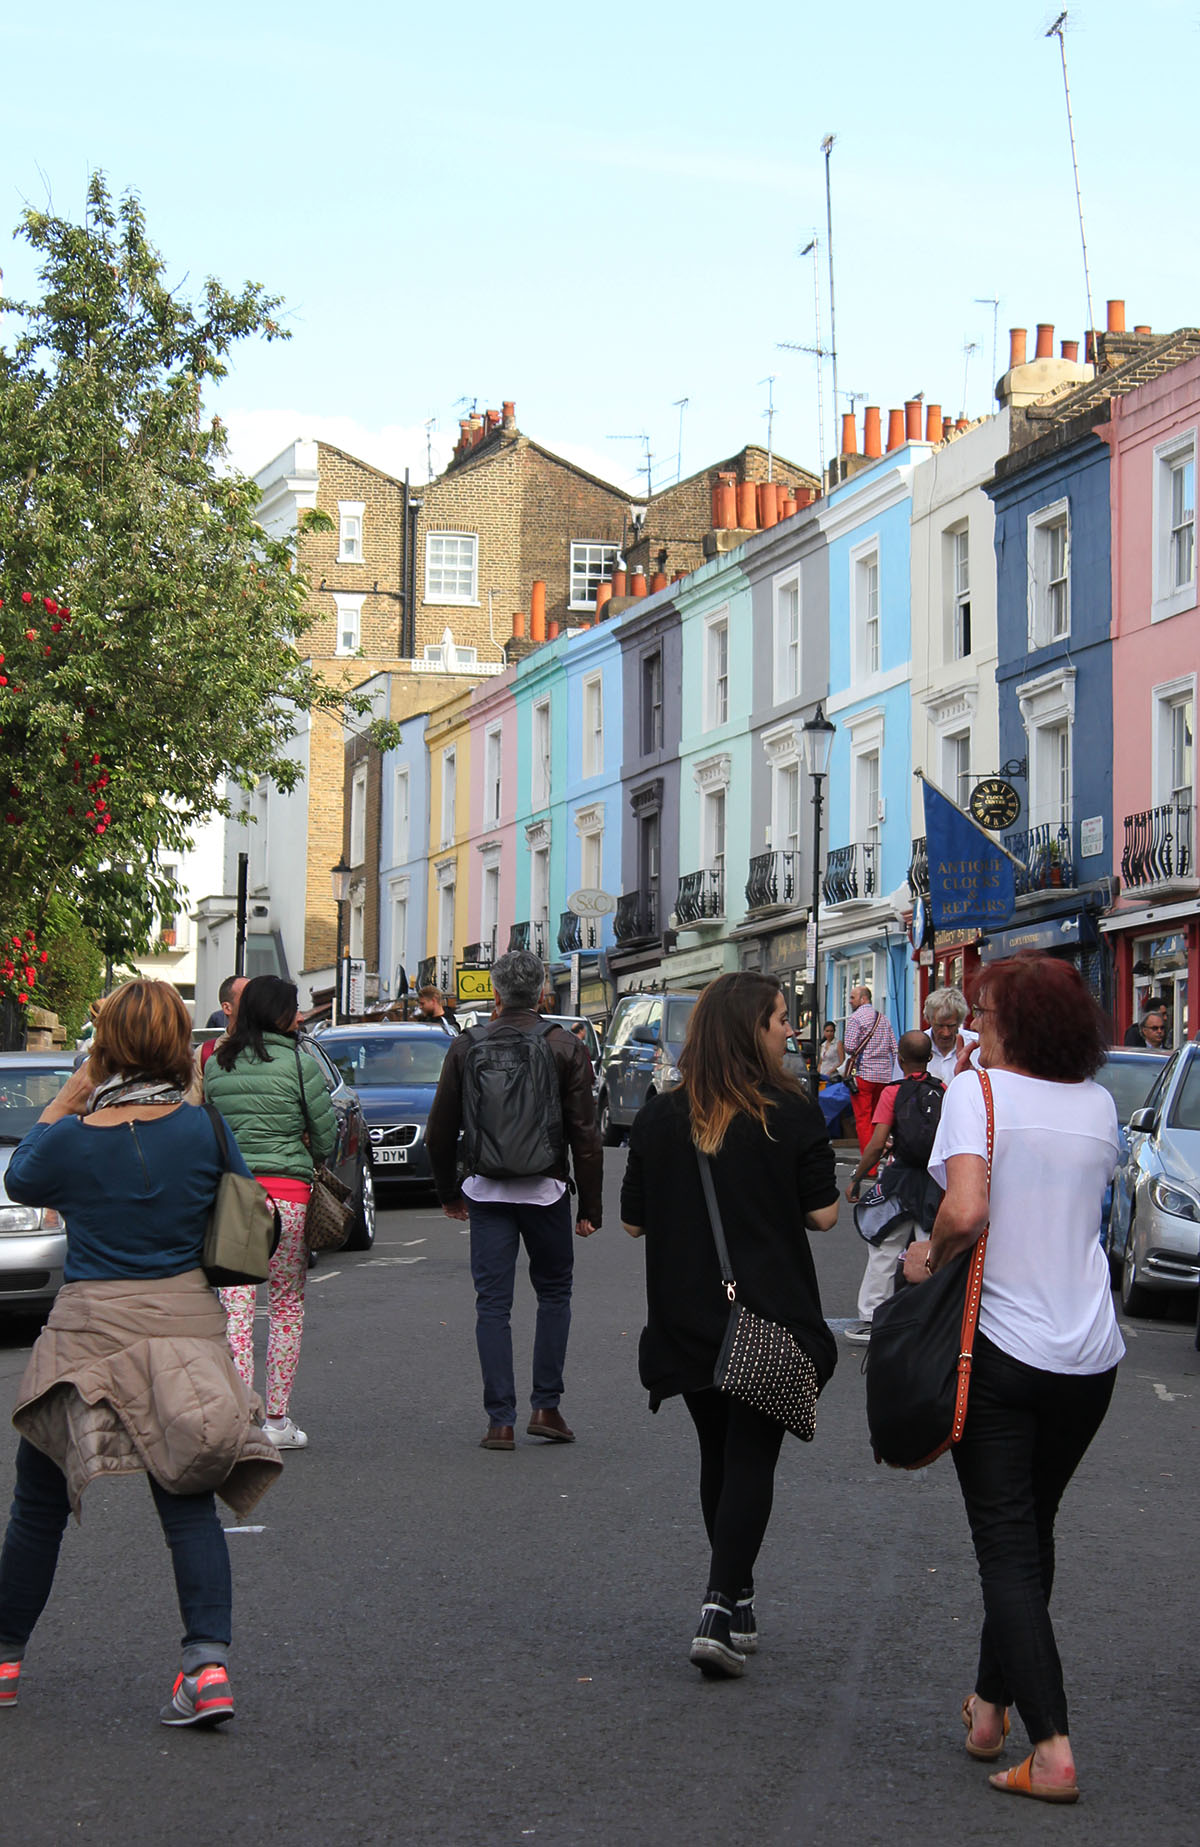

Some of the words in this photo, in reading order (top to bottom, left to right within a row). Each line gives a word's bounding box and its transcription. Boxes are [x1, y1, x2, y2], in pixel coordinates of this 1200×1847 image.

[937, 858, 1003, 875] ANTIQUE
[943, 875, 1000, 890] CLOCKS
[967, 889, 977, 900] &
[576, 894, 608, 913] S&C
[942, 899, 1006, 915] REPAIRS
[460, 974, 493, 994] Caf
[383, 1150, 406, 1162] DYM
